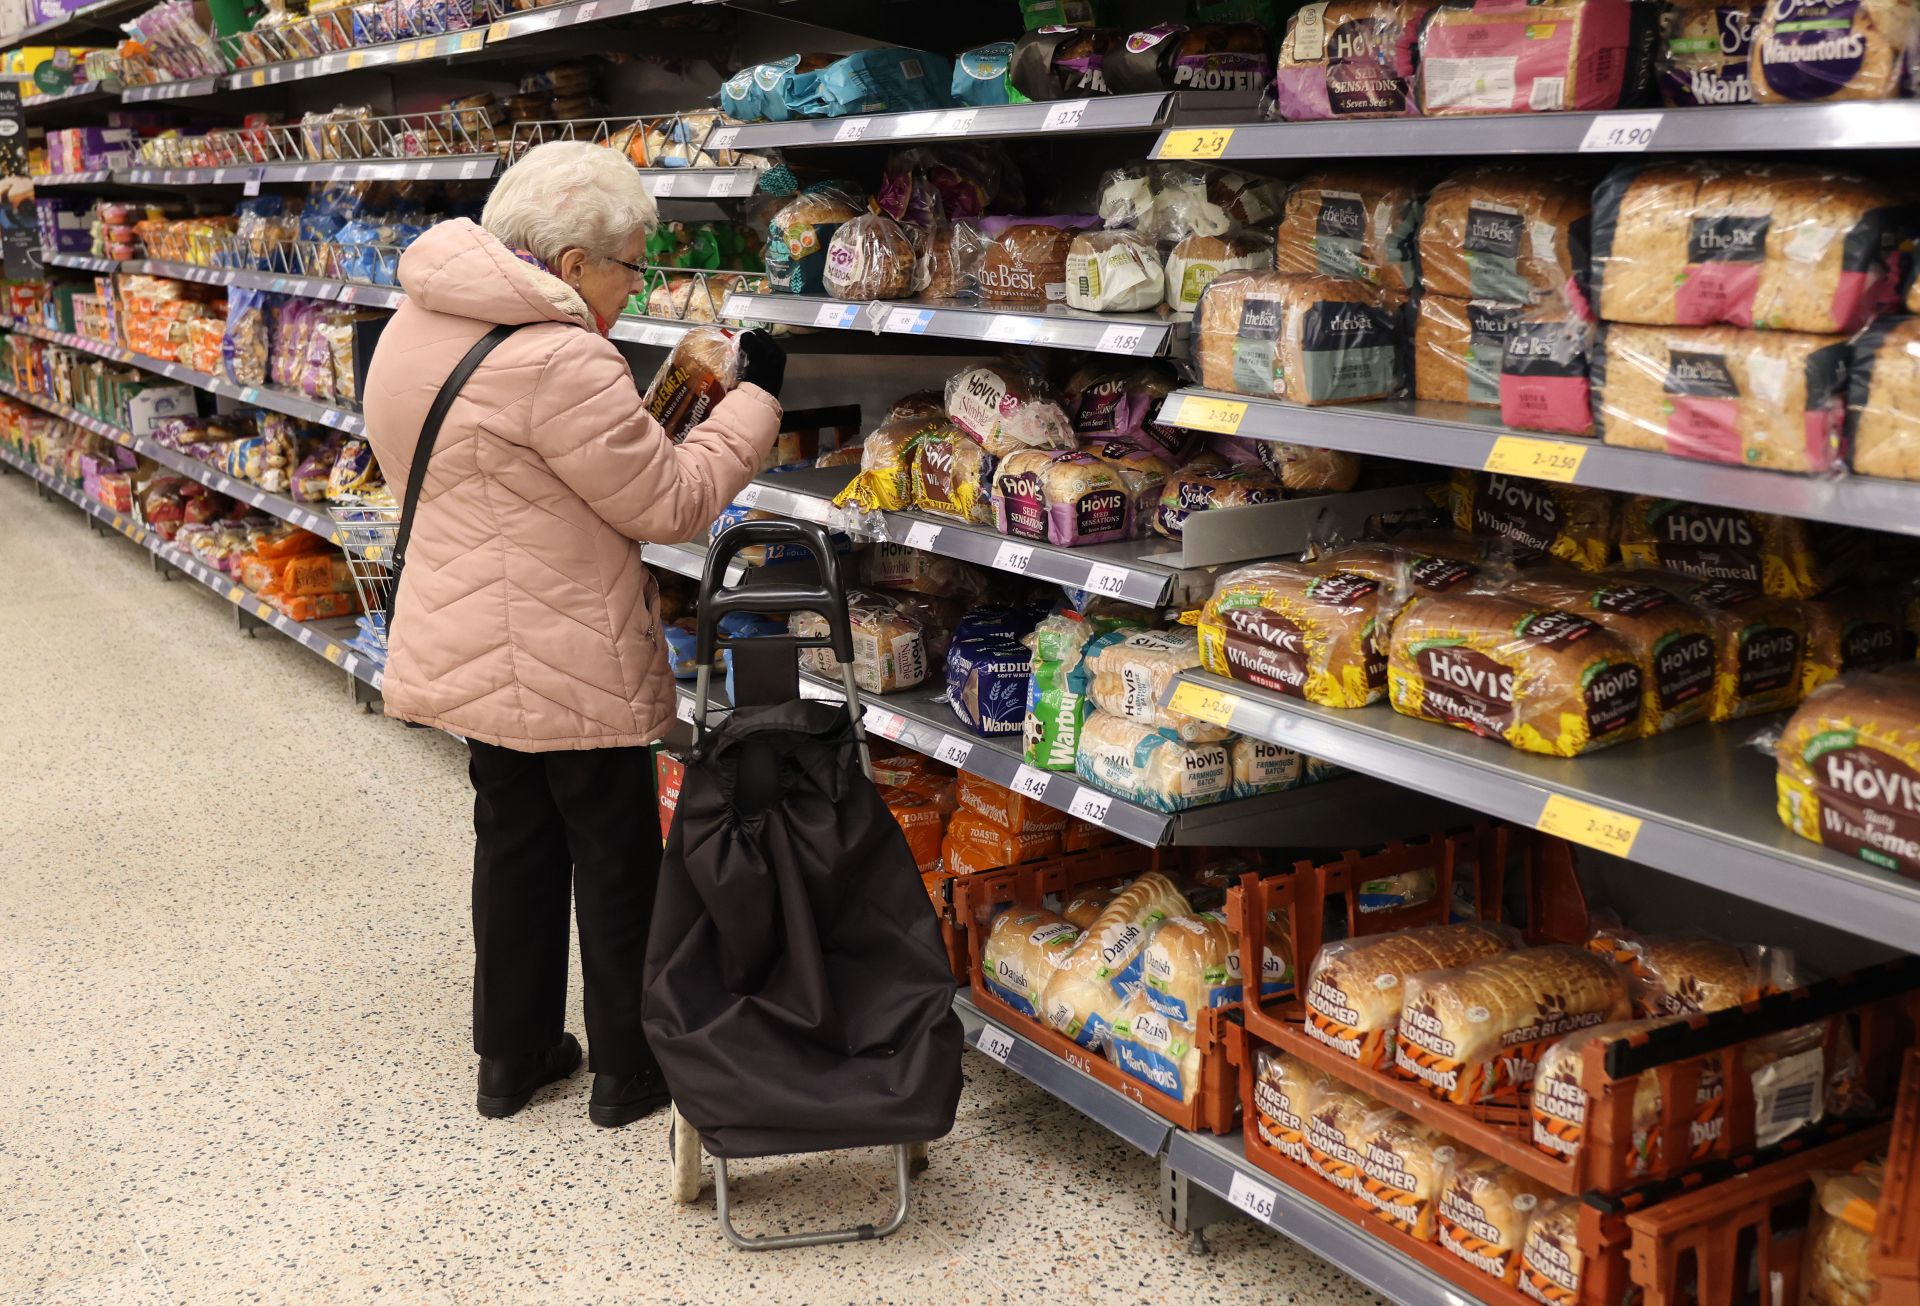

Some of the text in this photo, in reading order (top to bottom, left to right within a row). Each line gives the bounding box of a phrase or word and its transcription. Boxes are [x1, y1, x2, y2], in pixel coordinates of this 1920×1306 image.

[1762, 33, 1865, 65] Warburtons
[1174, 65, 1264, 92] PROTEIN
[1057, 110, 1082, 125] £2.75
[1192, 137, 1224, 152] 2 £3
[1609, 127, 1653, 145] £1.90
[1113, 335, 1138, 350] £1.85
[967, 374, 1000, 410] HOVIS
[1081, 496, 1121, 513] HOVIS
[1488, 473, 1556, 522] HOVIS
[1081, 515, 1120, 527] SENSATIONS
[1476, 509, 1548, 551] Wholemeal
[1667, 514, 1753, 547] HOVIS
[767, 545, 785, 559] 12
[1008, 553, 1028, 570] £1.15
[1665, 558, 1759, 581] Wholemeal
[1099, 575, 1123, 593] £1.20
[1231, 610, 1299, 654] HOVIS
[912, 636, 924, 680] HOVIS
[1257, 646, 1277, 661] Tasty
[1660, 638, 1709, 674] HOVIS
[1747, 635, 1794, 661] HOVIS
[1226, 646, 1304, 688] Wholemeal
[1429, 652, 1515, 703] HOVIS
[1126, 669, 1134, 716] HOVIS
[1250, 674, 1282, 690] MEDIUM
[1593, 669, 1639, 703] HOVIS
[948, 746, 968, 764] £1.30
[1185, 750, 1224, 770] HOVIS
[1256, 758, 1295, 769] FARMHOUSE
[1188, 769, 1224, 784] FARMHOUSE
[1196, 776, 1216, 787] BATCH
[1264, 765, 1285, 775] BATCH
[1024, 777, 1046, 795] £1.45
[1084, 801, 1106, 820] £1.25
[970, 828, 1000, 842] TOASTIE
[1032, 923, 1071, 942] Danish
[1102, 925, 1140, 964] Danish
[1146, 948, 1171, 976] Danish
[1314, 979, 1348, 1007] TIGER
[1308, 992, 1359, 1026] BLOOMER
[1406, 1007, 1443, 1034] TIGER
[990, 1039, 1011, 1059] £1.25
[1304, 1016, 1361, 1060] Warburtons
[1400, 1019, 1455, 1058] BLOOMER
[1502, 1025, 1539, 1047] TIGER
[1396, 1044, 1458, 1091] Warburtons
[1258, 1081, 1290, 1111] TIGER
[1255, 1092, 1301, 1130] BLOOMER
[1311, 1115, 1345, 1145] TIGER
[1366, 1143, 1405, 1170] TIGER
[1245, 1191, 1272, 1217] £1.65
[1446, 1189, 1485, 1220] TIGER
[1439, 1200, 1500, 1244] BLOOMER
[1439, 1224, 1505, 1279] Warburtons
[1533, 1232, 1571, 1268] TIGER
